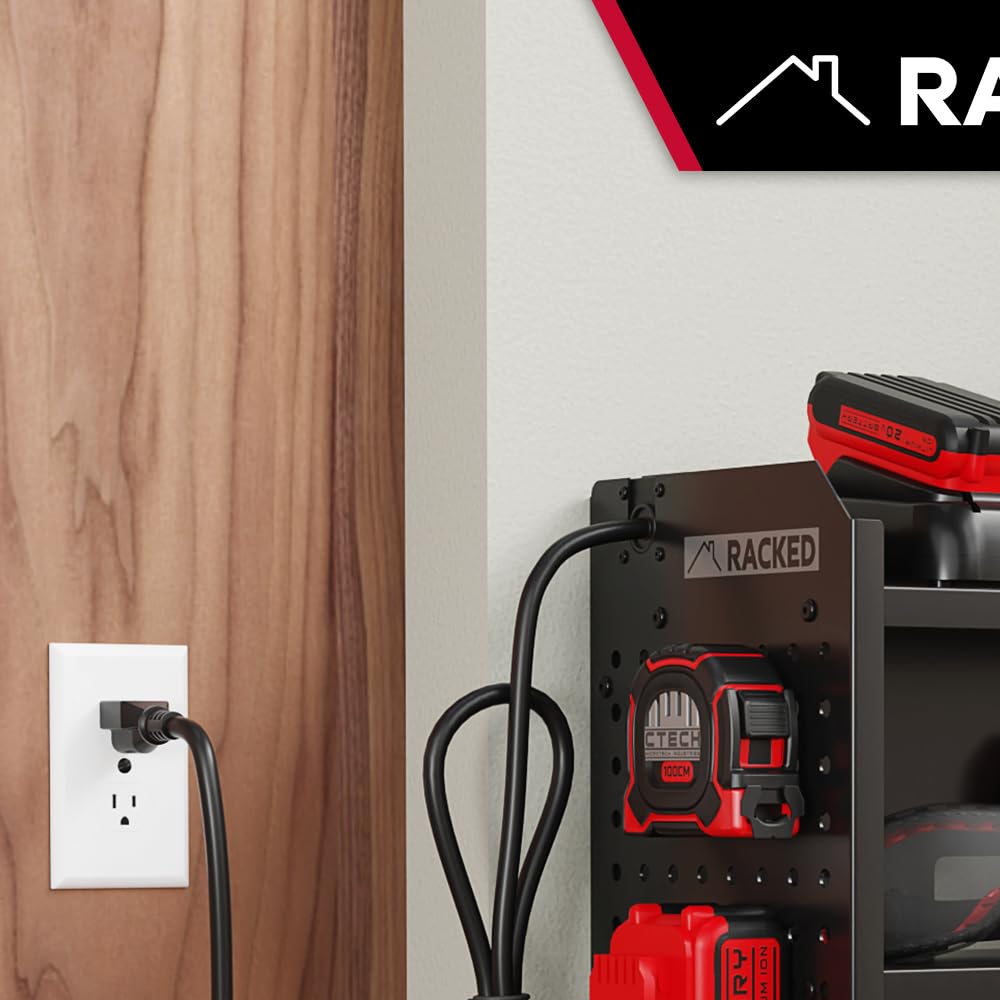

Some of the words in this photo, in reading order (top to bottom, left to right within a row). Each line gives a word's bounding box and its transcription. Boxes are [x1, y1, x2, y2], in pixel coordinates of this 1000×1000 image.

[727, 534, 816, 572] RACKED
[645, 731, 701, 747] CTECH
[759, 946, 769, 975] ION
